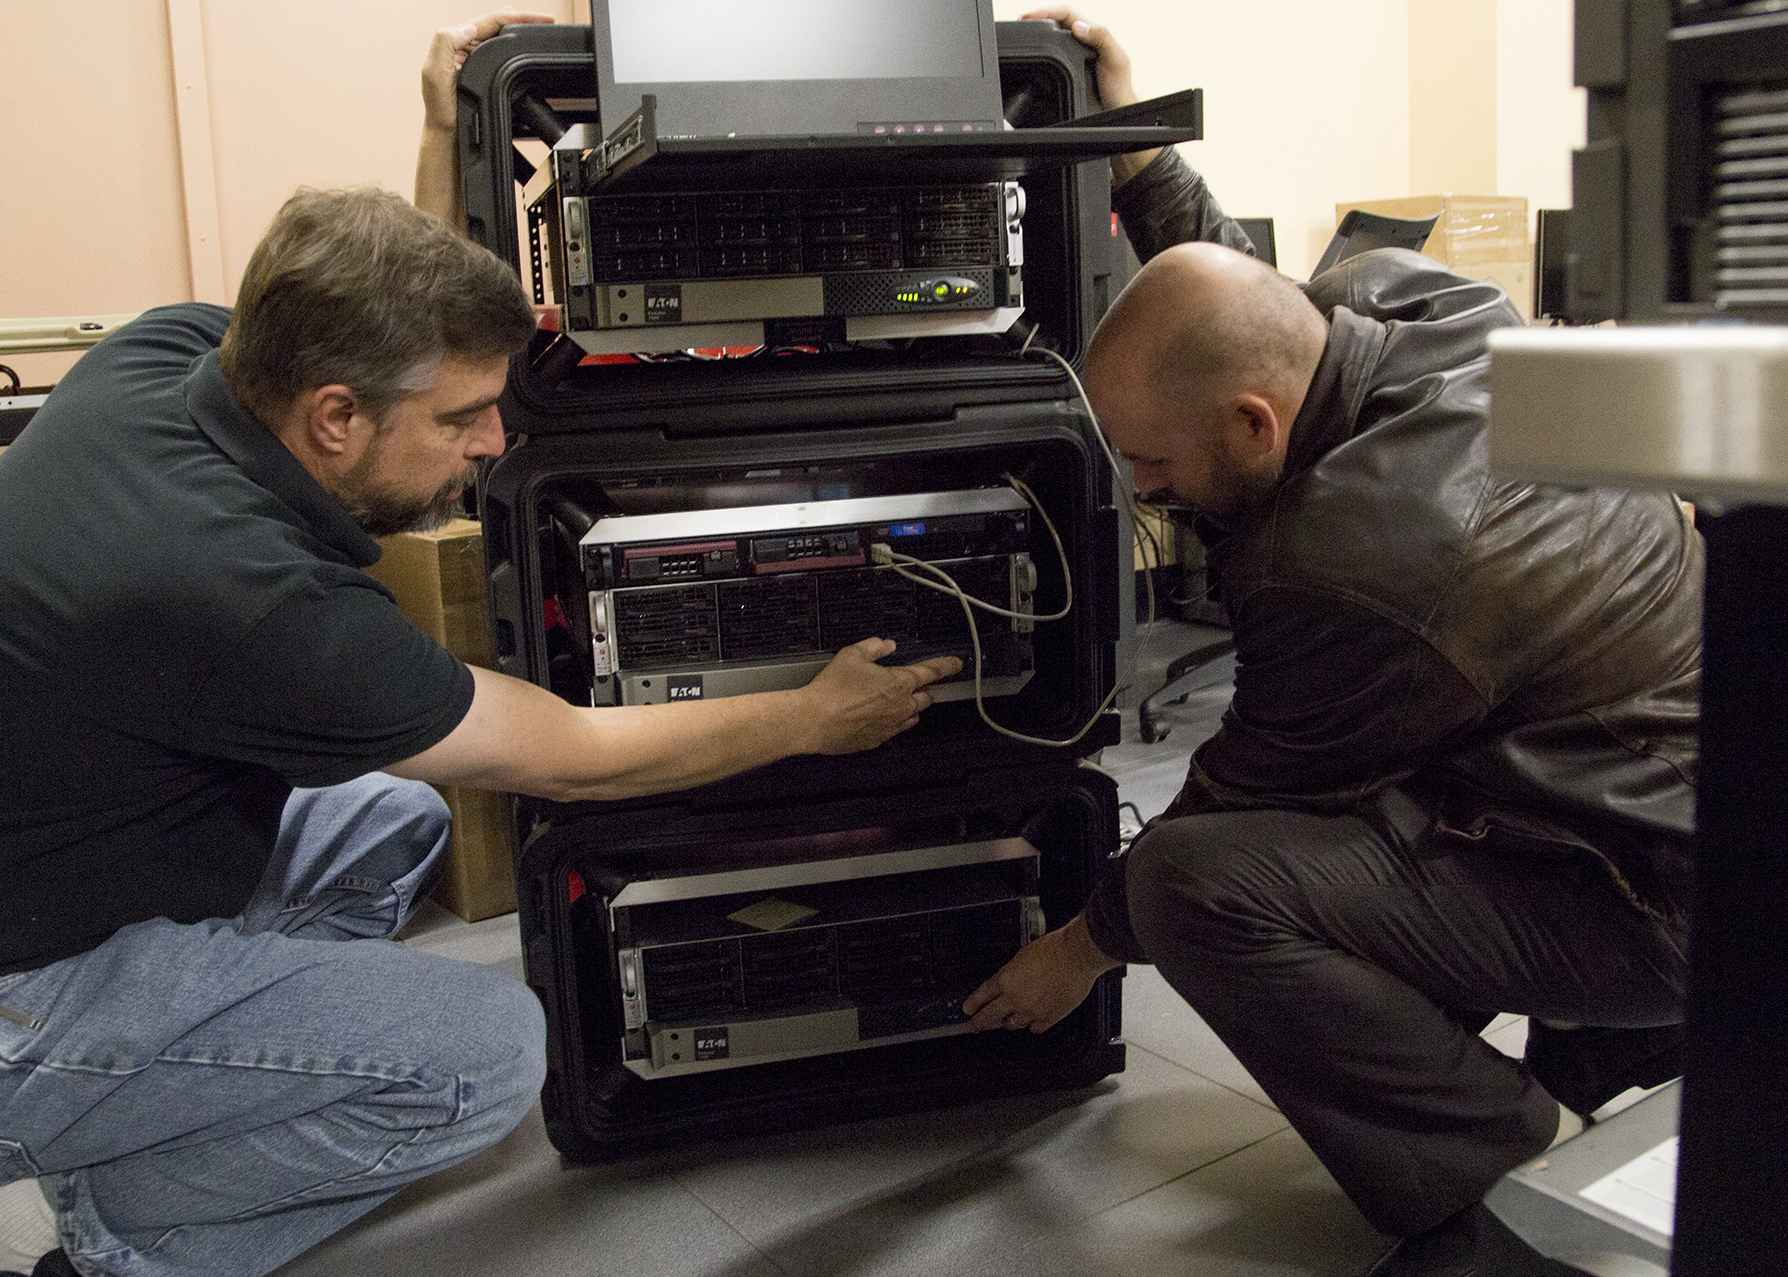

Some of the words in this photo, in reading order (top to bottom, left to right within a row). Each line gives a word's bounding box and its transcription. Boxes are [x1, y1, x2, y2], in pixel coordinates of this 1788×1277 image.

[648, 298, 679, 308] EATON
[670, 686, 701, 698] EATON
[698, 1039, 727, 1049] EATON
